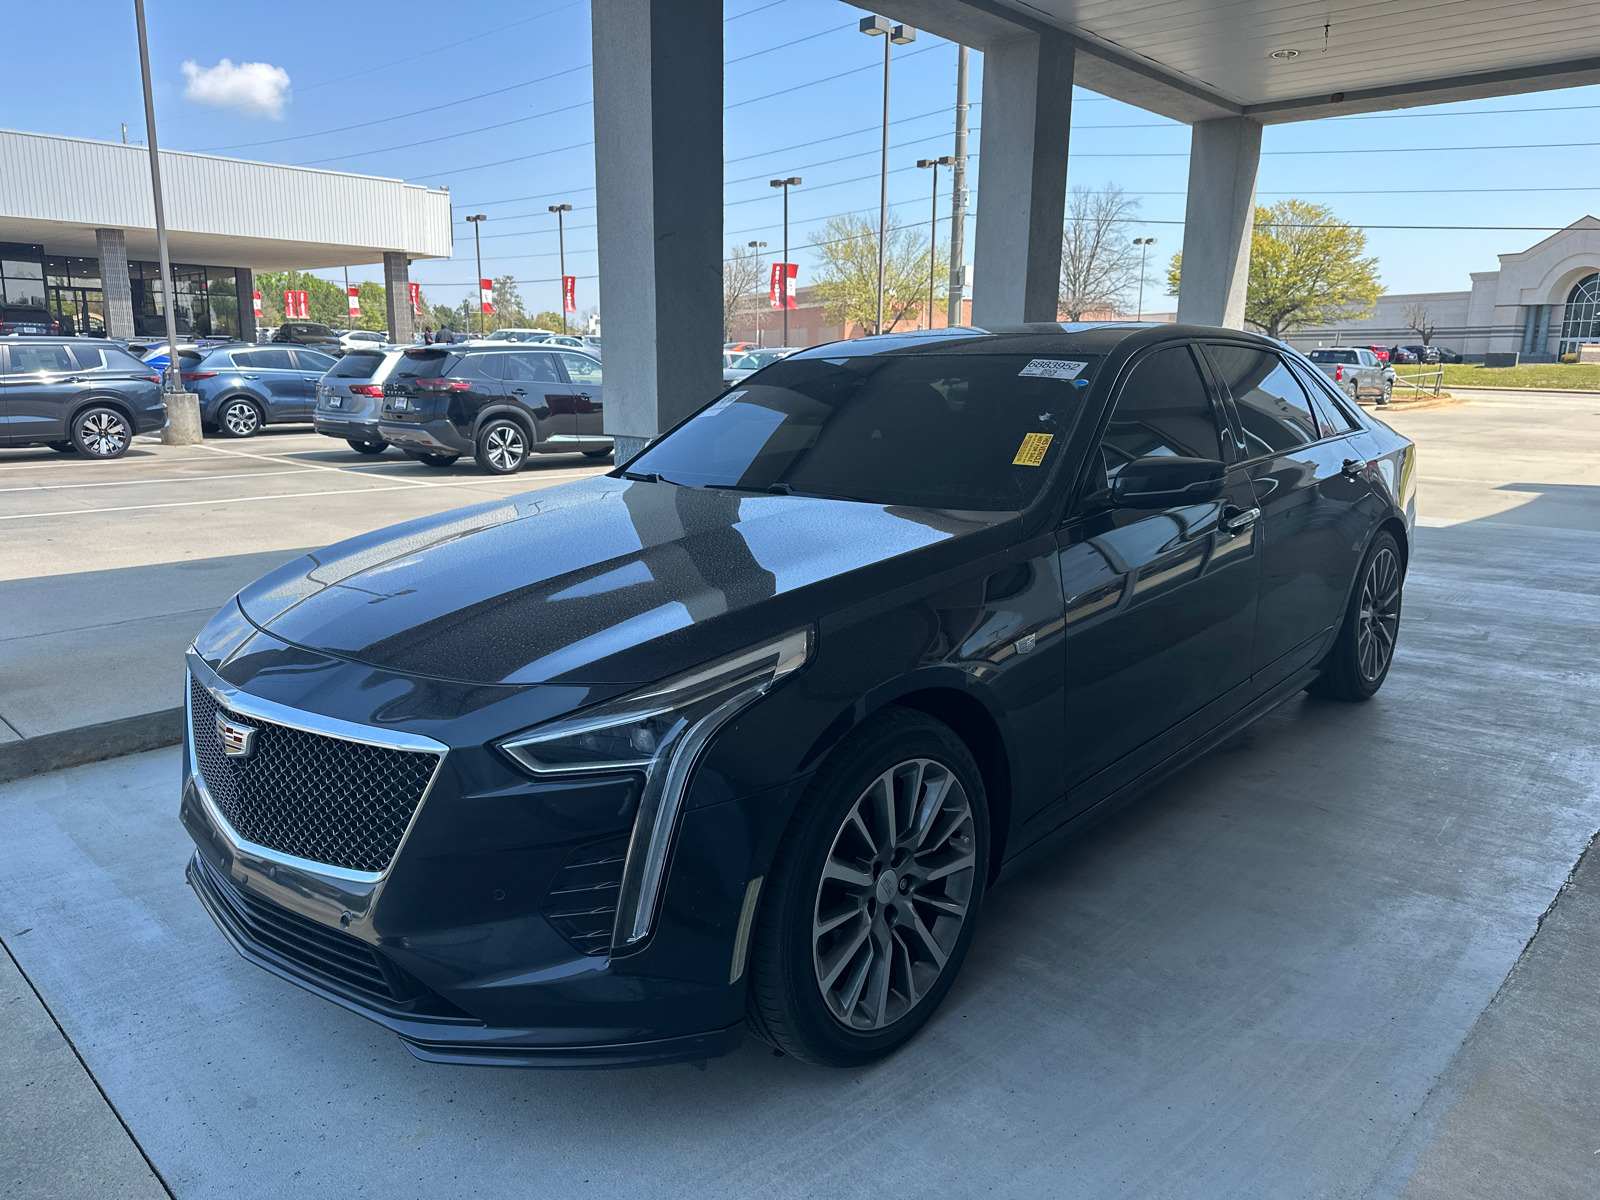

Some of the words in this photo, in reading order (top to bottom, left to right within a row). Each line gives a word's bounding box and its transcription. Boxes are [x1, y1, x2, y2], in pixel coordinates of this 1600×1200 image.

[1028, 360, 1080, 370] 6883952
[1042, 435, 1052, 446] THIS
[1032, 443, 1040, 452] FOR
[1027, 452, 1036, 463] SALE
[1032, 446, 1047, 464] VEHICLE
